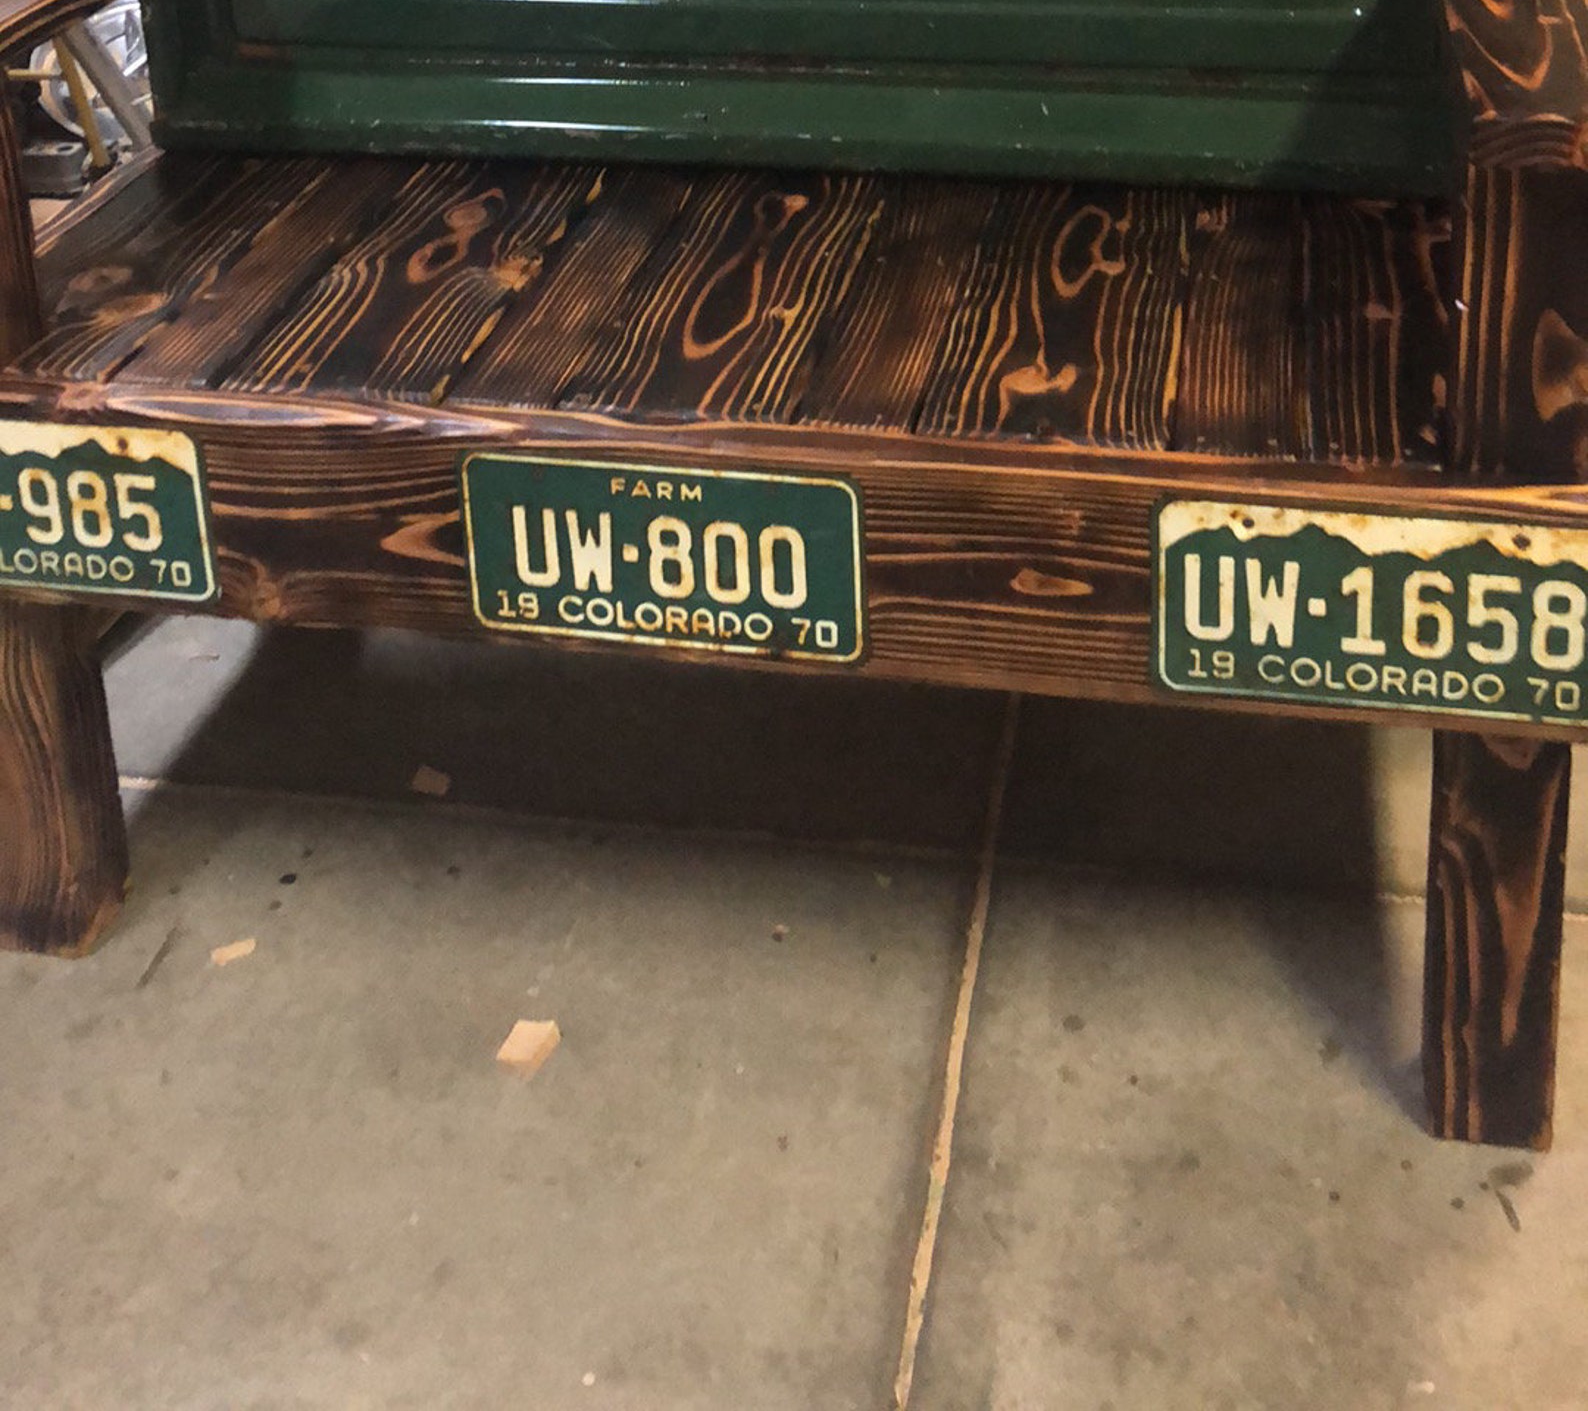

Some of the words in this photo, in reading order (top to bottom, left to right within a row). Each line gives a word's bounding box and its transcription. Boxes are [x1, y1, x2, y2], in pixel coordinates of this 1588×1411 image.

[610, 477, 703, 503] FARM
[150, 560, 192, 588] 70
[497, 589, 540, 619] 19
[558, 594, 774, 641] COLORADO
[790, 617, 840, 649] 70
[1187, 648, 1235, 680] 19
[1257, 653, 1506, 705] COLORADO
[1526, 676, 1581, 712] 70
